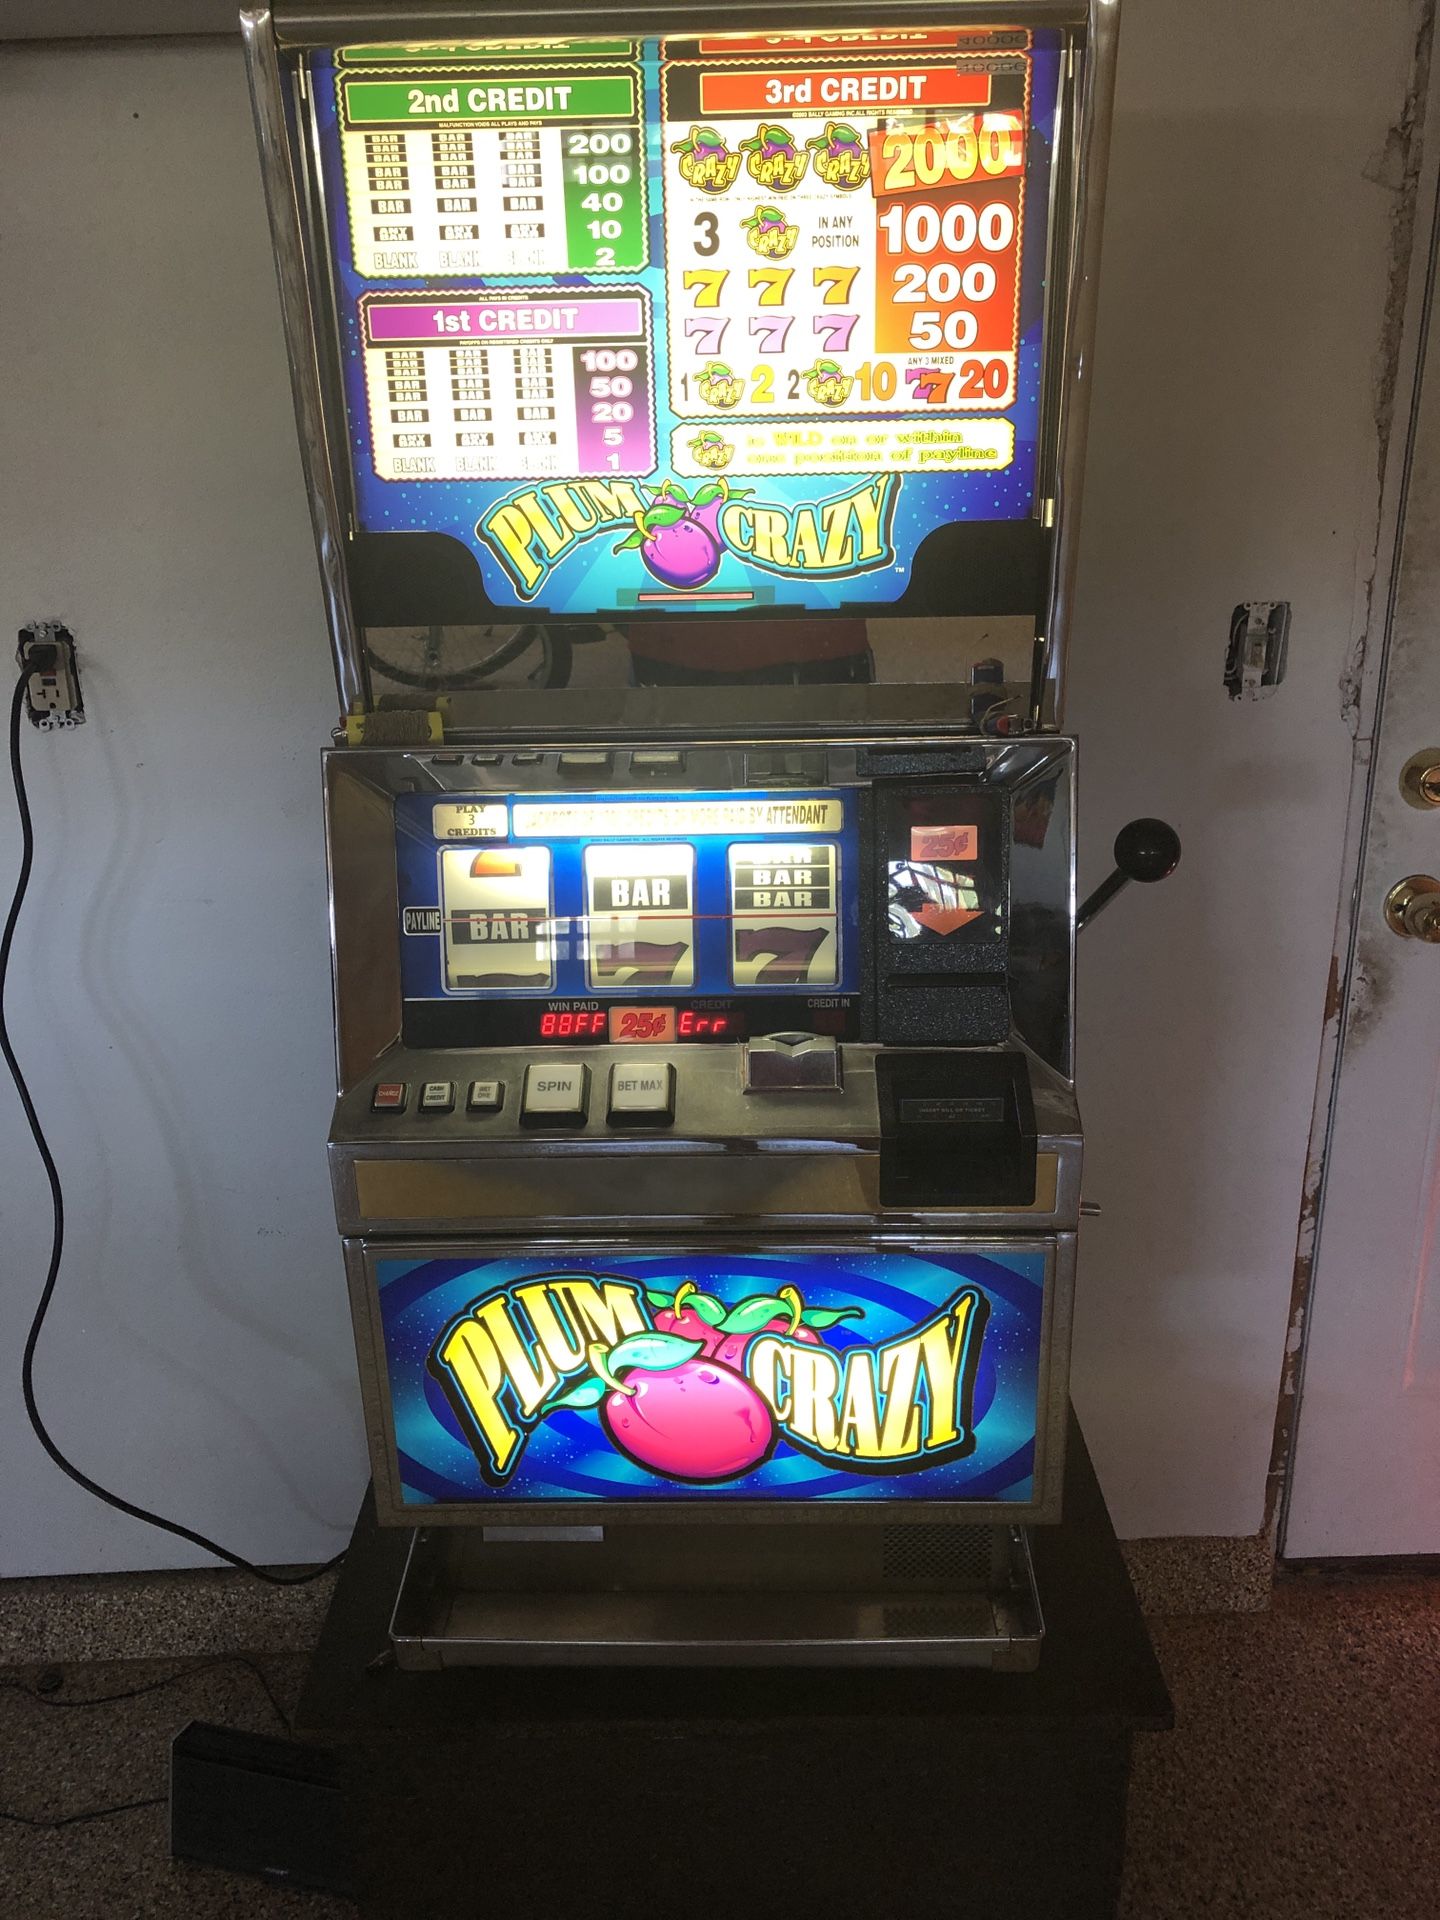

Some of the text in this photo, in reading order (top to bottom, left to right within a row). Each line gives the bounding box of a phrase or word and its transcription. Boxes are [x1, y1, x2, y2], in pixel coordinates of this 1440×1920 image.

[407, 86, 572, 114] 2nd CREDIT
[764, 75, 927, 105] 3rd CREDIT
[568, 132, 632, 155] 200
[746, 148, 811, 187] CRAZY
[881, 124, 1015, 191] 2000
[375, 167, 401, 177] BAR
[442, 166, 468, 176] BAR
[573, 163, 631, 186] 100
[679, 150, 743, 188] CRAZY
[376, 180, 402, 190] BAR
[442, 178, 469, 188] BAR
[378, 200, 404, 213] BAR
[444, 198, 470, 212] BAR
[581, 191, 624, 213] 40
[586, 219, 622, 240] 10
[818, 215, 853, 229] IN ANY
[878, 201, 1015, 255] 1000
[692, 211, 720, 257] 3
[747, 226, 800, 255] CRAZY
[811, 235, 860, 248] POSITION
[374, 252, 418, 270] BLANK
[594, 247, 616, 267] 2
[683, 262, 998, 308] 7 7 7 200
[432, 307, 579, 333] 1st CREDIT
[684, 310, 979, 354] 7 7 7 50
[580, 349, 638, 372] 100
[908, 357, 923, 365] ANY
[931, 356, 954, 365] MIXED
[395, 380, 420, 390] BAR
[396, 392, 421, 401] BAR
[589, 376, 633, 398] 50
[680, 372, 688, 401] 1
[699, 378, 746, 405] CRAZY
[750, 364, 775, 402] 2
[787, 369, 800, 399] 2
[806, 376, 854, 404] CRAZY
[855, 361, 897, 401] 10
[920, 372, 956, 403] 7
[959, 359, 1009, 399] 20
[398, 410, 422, 422] BAR
[591, 402, 633, 424] 20
[603, 427, 623, 446] 5
[895, 430, 963, 444] within
[393, 457, 436, 473] BLANK
[606, 452, 620, 470] 1
[890, 447, 911, 460] of
[919, 446, 998, 464] payline
[487, 479, 645, 590] PLUM
[722, 473, 891, 569] CRAZY
[455, 804, 486, 815] PLAY
[468, 814, 475, 826] 3
[766, 804, 828, 826] ATTENDANT
[447, 827, 497, 838] CREDITS
[920, 831, 969, 858] 25¢
[753, 869, 812, 886] BAR
[610, 878, 671, 907] BAR
[753, 891, 812, 907] BAR
[405, 911, 440, 931] PAYLINE
[469, 913, 530, 941] BAR
[548, 1001, 599, 1011] WIN PAID
[807, 998, 850, 1008] CREDIT IN
[620, 1012, 667, 1038] 25¢
[678, 1012, 727, 1033] Err
[536, 1080, 572, 1092] SPIN
[617, 1080, 663, 1091] BET MAX
[443, 1282, 972, 1471] PLUM CRAZY
